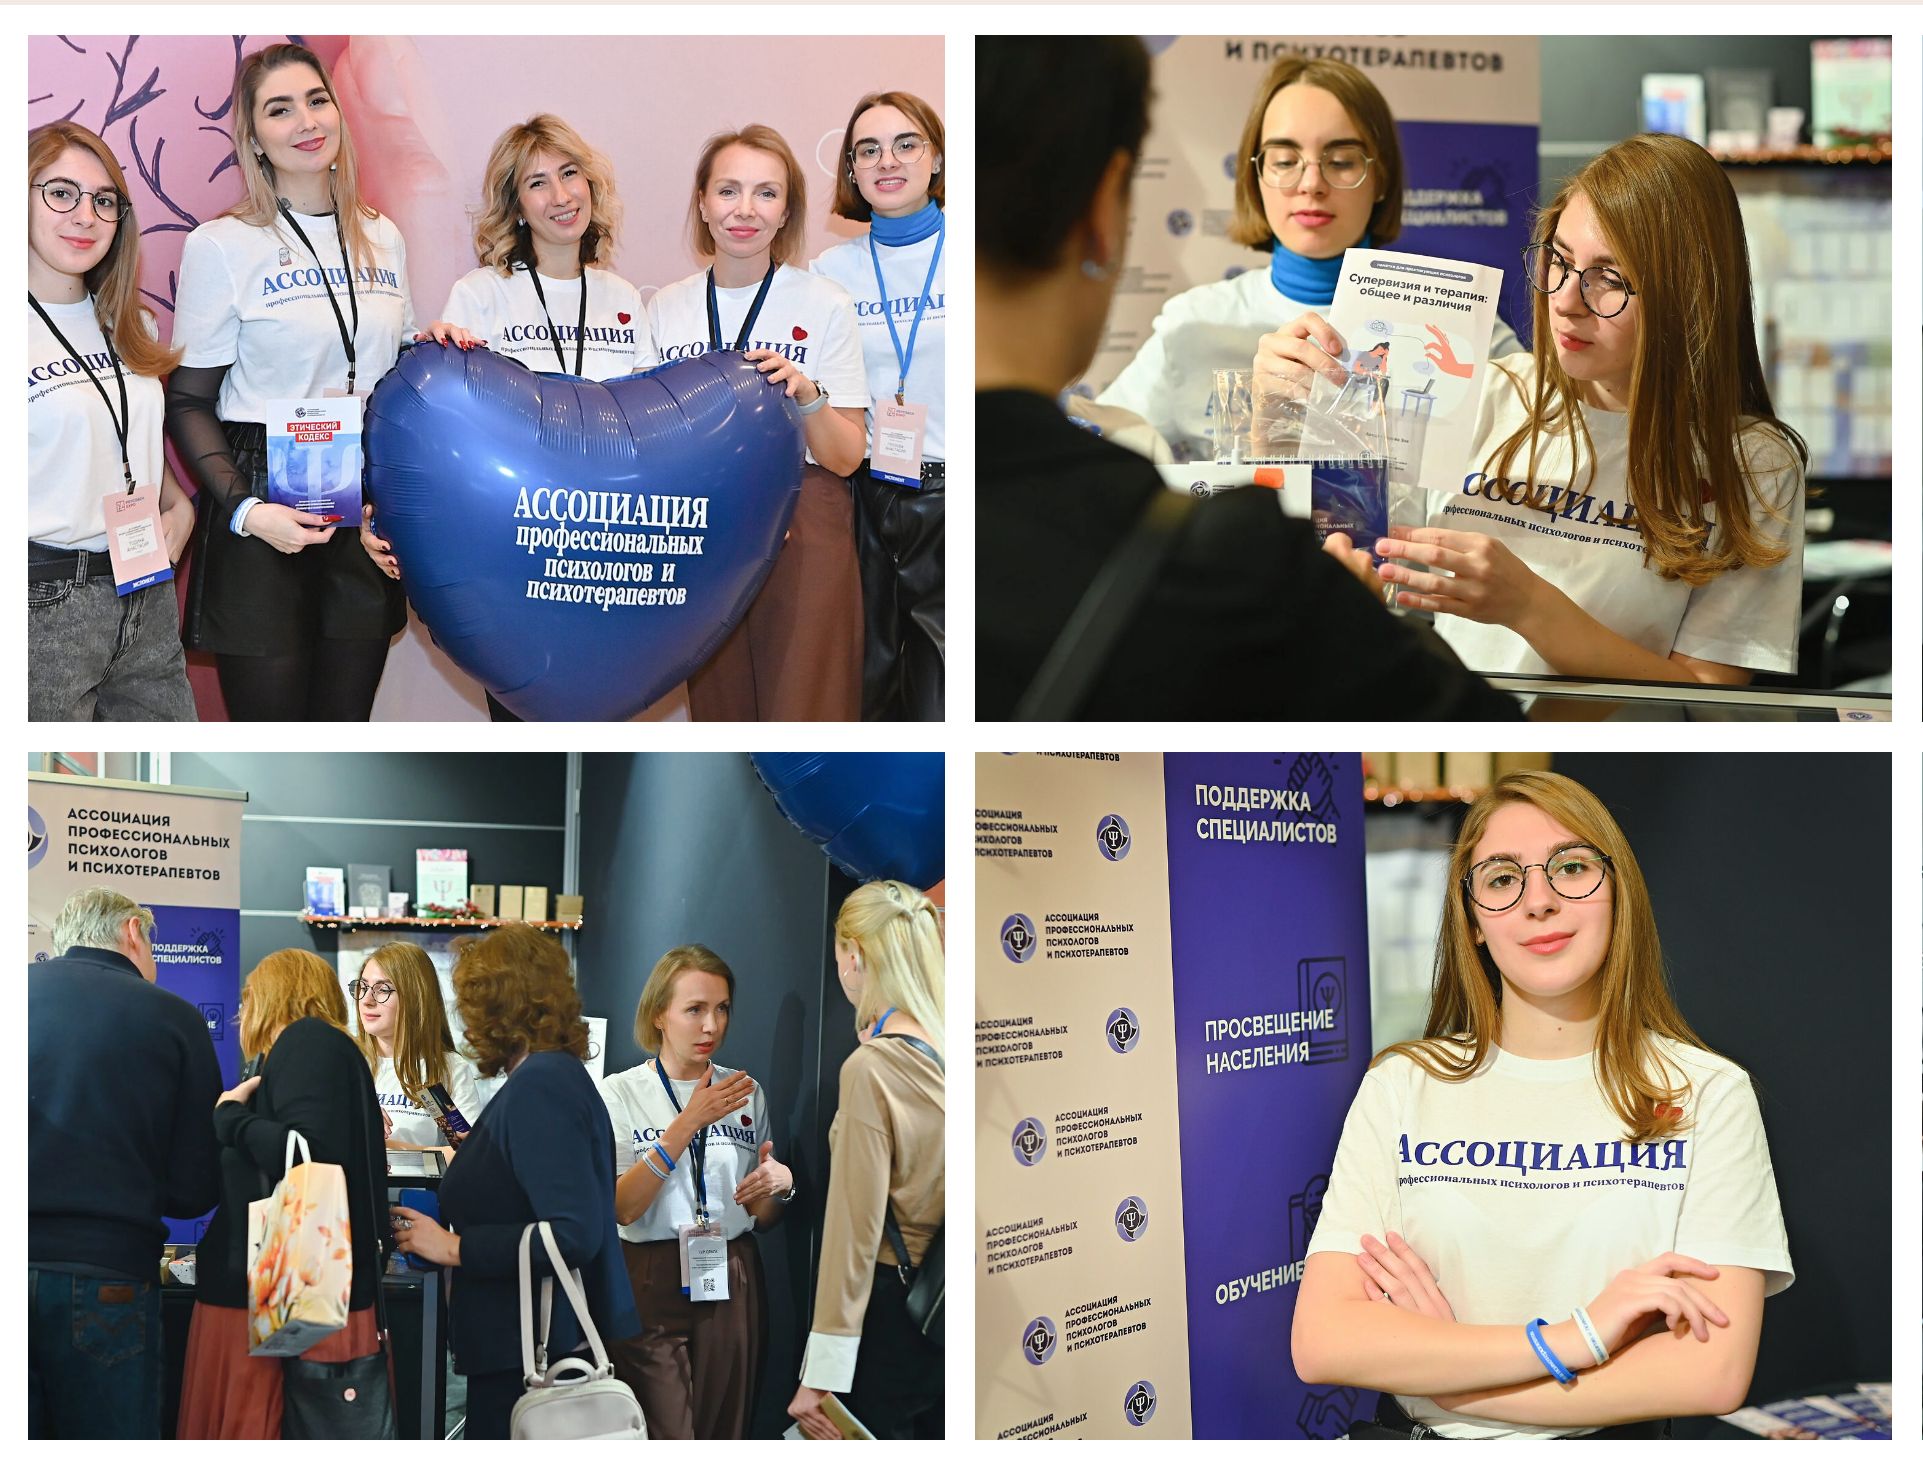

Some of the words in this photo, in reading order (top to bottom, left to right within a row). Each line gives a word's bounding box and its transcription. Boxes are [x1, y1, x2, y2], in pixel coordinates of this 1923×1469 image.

[1349, 273, 1420, 292] Супервизия
[1424, 284, 1431, 293] и
[1435, 286, 1488, 303] терапия:
[854, 294, 944, 317] СОЦИА
[1360, 287, 1400, 300] общее
[1403, 294, 1411, 302] и
[1413, 295, 1472, 312] различия
[28, 353, 124, 387] ССОЦИ
[290, 422, 338, 431] ЭТИЧЕСКИЙ
[298, 432, 330, 441] КОДЕКС
[513, 486, 709, 535] АССОЦИАЦИЯ
[1443, 504, 1527, 528] рфессиональных
[1528, 522, 1591, 544] психологов
[1593, 536, 1600, 544] и
[516, 521, 704, 556] профессиональных
[544, 558, 652, 582] психологов
[661, 563, 676, 583] и
[526, 580, 687, 612] психотерапевтов
[1195, 784, 1311, 812] ПОДДЕРЖКА
[67, 807, 171, 827] АССОЦИАЦИЯ
[68, 825, 230, 849] ПРОФЕССИОНАЛЬНЫХ
[1197, 817, 1337, 844] СПЕЦИАЛИСТОВ
[68, 843, 168, 861] ПСИХОЛОГОВ
[68, 861, 78, 872] И
[83, 861, 220, 881] ПСИХОТЕРАПЕВТОВ
[1045, 913, 1099, 923] АССОЦИАЦИЯ
[1046, 923, 1134, 935] ПРОФЕССИОНАЛЬНЫХ
[152, 943, 208, 954] ПОДДЕРЖКА
[1046, 937, 1099, 947] ПСИХОЛОГОВ
[152, 953, 222, 965] СПЕЦИАЛИСТОВ
[1047, 951, 1053, 959] И
[1054, 947, 1129, 960] ПСИХОТЕРАПЕВТОВ
[975, 1016, 1033, 1030] АССОЦИАЦИЯ
[975, 1025, 1068, 1042] ПРОФЕССИОНАЛЬНЫХ
[1205, 1008, 1334, 1042] ПРОСВЕЩЕНИЕ
[976, 1041, 1033, 1056] ПСИХОЛОГОВ
[976, 1060, 983, 1068] И
[985, 1050, 1063, 1068] ПСИХОТЕРАПЕВТОВ
[1206, 1041, 1310, 1075] НАСЕЛЕНИЯ
[1055, 1106, 1109, 1122] АССОЦИАЦИЯ
[1056, 1113, 1143, 1134] ПРОФЕССИОНАЛЬНЫХ
[1056, 1130, 1109, 1146] ПСИХОЛОГОВ
[1057, 1149, 1063, 1158] И
[1064, 1137, 1138, 1158] ПСИХОТЕРАПЕВТОВ
[1398, 1133, 1688, 1176] АССОЦИАЦИЯ
[1500, 1180, 1570, 1190] психологов
[1583, 1178, 1685, 1191] психотерапевтов
[985, 1217, 1044, 1238] АССОЦИАЦИЯ
[986, 1221, 1078, 1250] ПРОФЕССИОНАЛЬНЫХ
[987, 1242, 1044, 1262] ПСИХОЛОГОВ
[988, 1267, 995, 1275] И
[996, 1246, 1073, 1273] ПСИХОТЕРАПЕВТОВ
[1215, 1260, 1305, 1305] ОБУЧЕНИЕ
[1065, 1295, 1118, 1318] АССОЦИАЦИЯ
[1065, 1298, 1152, 1329] ПРОФЕССИОНАЛЬНЫХ
[1066, 1319, 1118, 1341] ПСИХОЛОГОВ
[1067, 1344, 1073, 1352] И
[1074, 1322, 1147, 1351] ПСИХОТЕРАПЕВТОВ
[997, 1413, 1054, 1440] АССОЦИАЦИЯ
[1017, 1412, 1088, 1440] ЕССИОНАЛЬНЫХ
